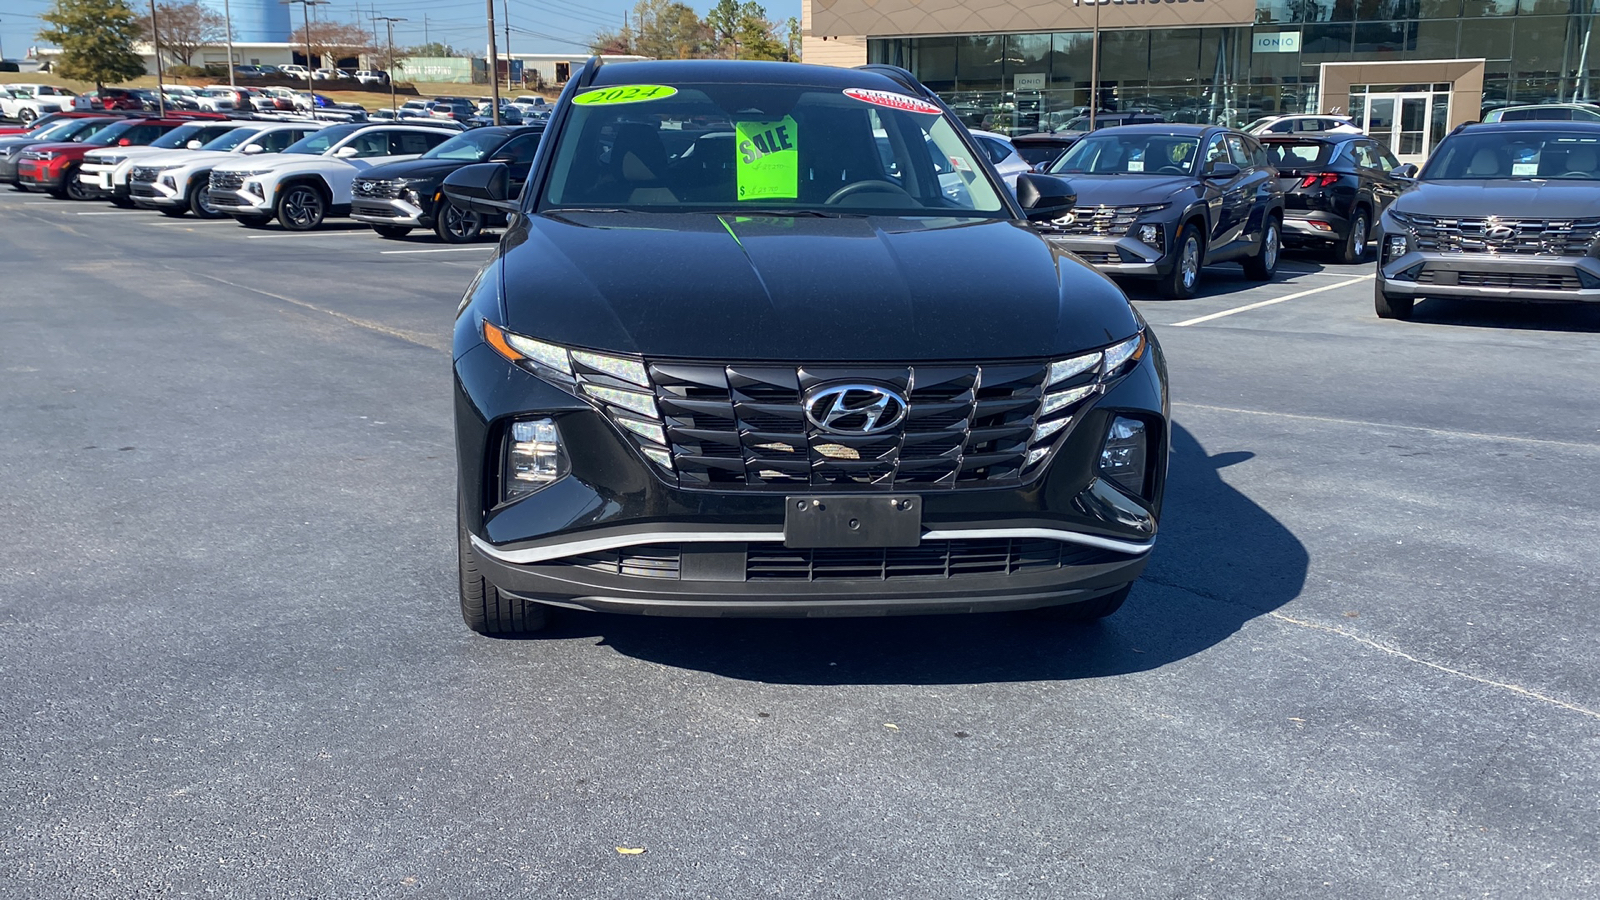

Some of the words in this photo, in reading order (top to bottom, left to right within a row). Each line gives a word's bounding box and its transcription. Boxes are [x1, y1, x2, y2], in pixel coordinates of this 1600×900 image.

[586, 87, 662, 104] 2024
[855, 88, 931, 108] CERTIFIED
[739, 125, 793, 165] SALE
